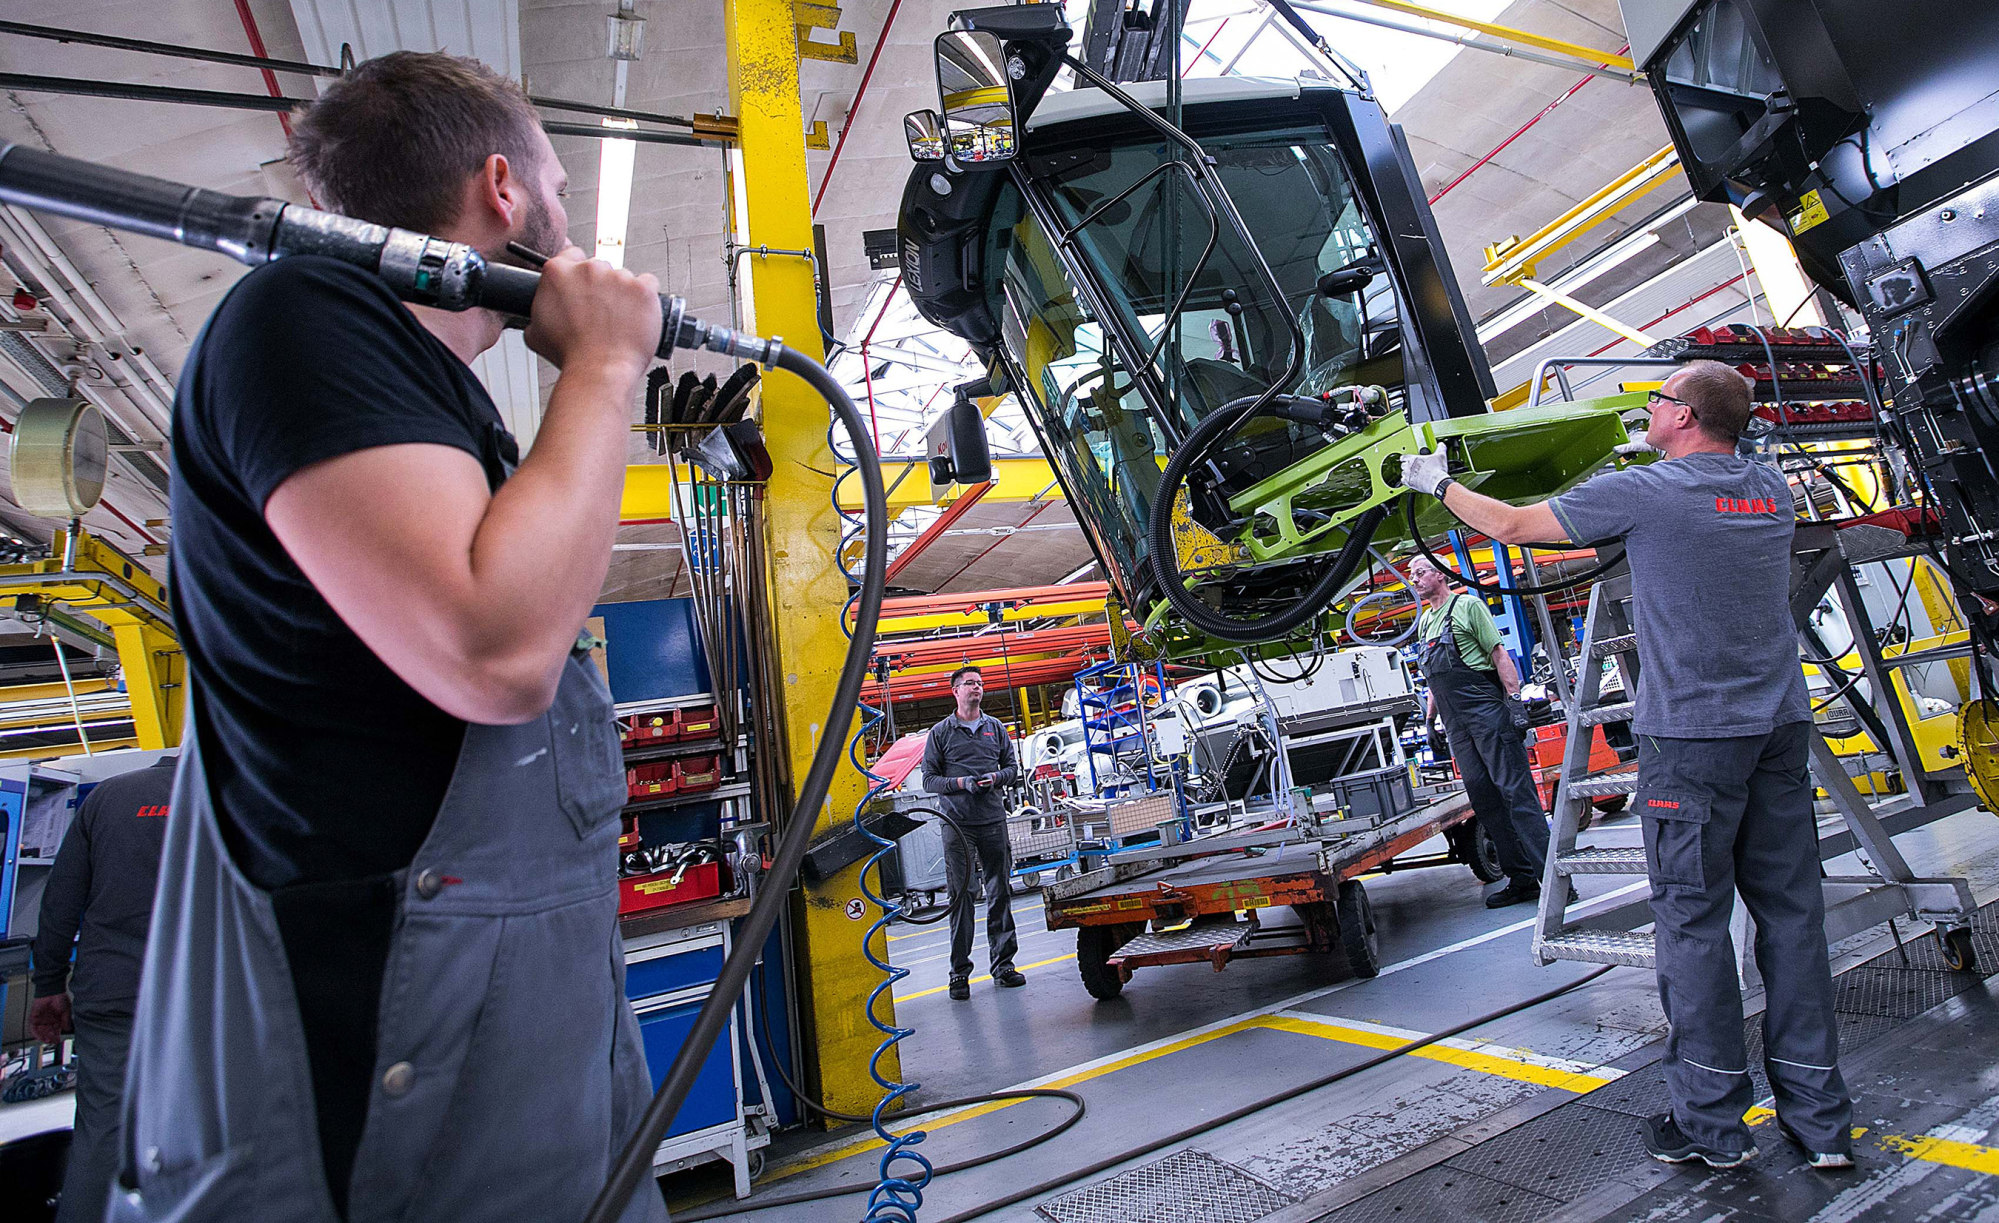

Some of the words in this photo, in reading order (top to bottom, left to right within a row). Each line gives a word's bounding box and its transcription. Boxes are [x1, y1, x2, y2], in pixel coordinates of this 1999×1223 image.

[905, 237, 924, 293] LEXION
[1715, 497, 1777, 513] CLAAS
[136, 805, 171, 817] CLA
[1647, 798, 1680, 810] CLAAS
